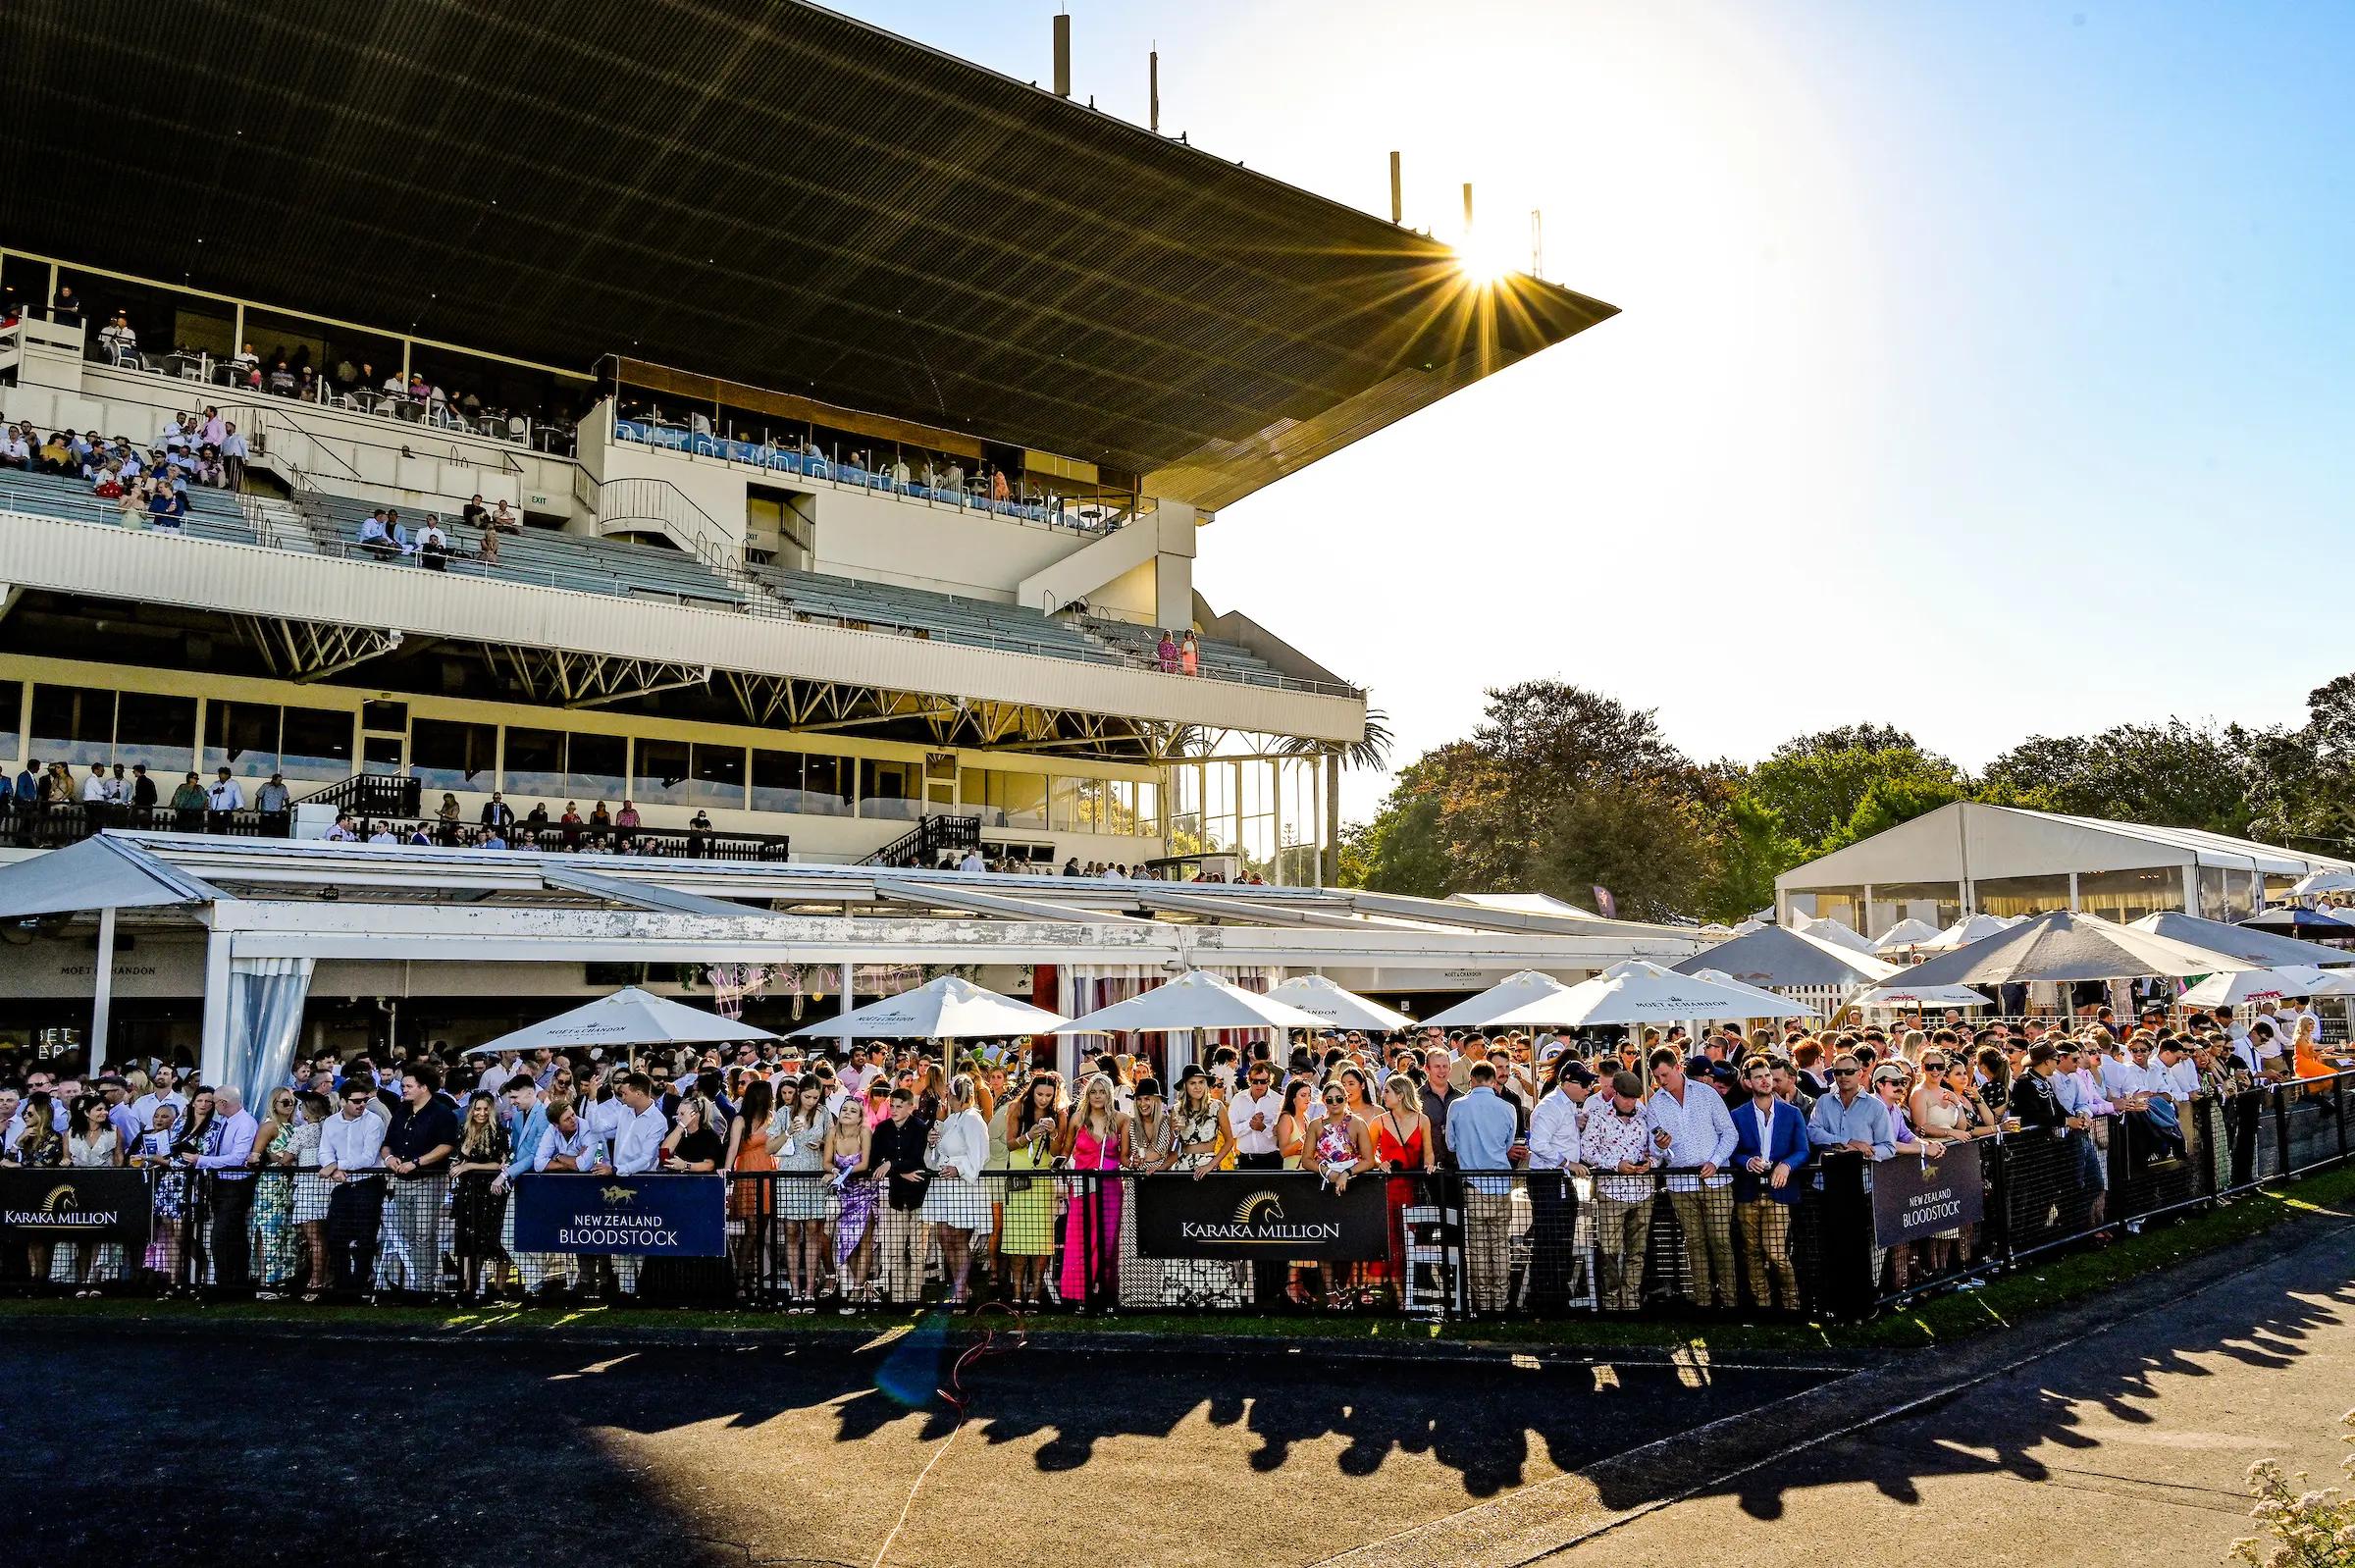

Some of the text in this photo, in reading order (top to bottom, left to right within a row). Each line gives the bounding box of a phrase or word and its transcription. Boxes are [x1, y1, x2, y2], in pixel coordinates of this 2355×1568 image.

[532, 496, 547, 504] EXIT
[1909, 1188, 1952, 1207] NEW ZEALAND
[5, 1210, 118, 1224] KARAKA MILLION
[574, 1215, 662, 1227] NEW ZEALAND
[1903, 1200, 1961, 1228] BLOODSTOCK
[559, 1228, 678, 1245] BLOODSTOCK
[1181, 1222, 1340, 1238] KARAKA MILLION
